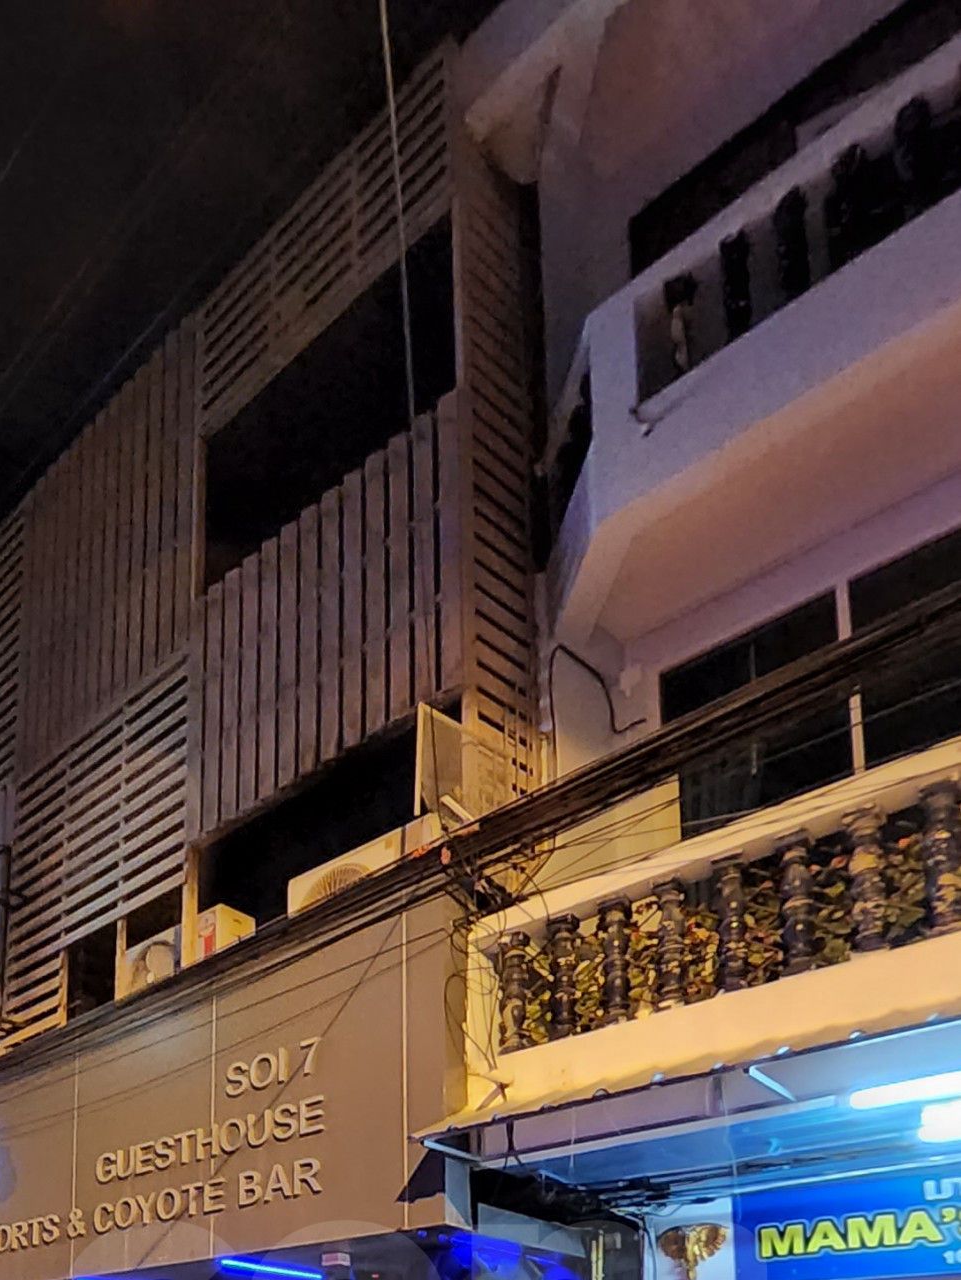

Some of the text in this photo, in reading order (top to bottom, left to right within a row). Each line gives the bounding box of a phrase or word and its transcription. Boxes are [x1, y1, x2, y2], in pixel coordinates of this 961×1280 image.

[225, 1036, 322, 1097] SOI 7
[95, 1094, 326, 1184] GUESTHOUSE
[66, 1206, 86, 1239] &
[93, 1176, 227, 1235] COYOTE
[238, 1157, 323, 1210] BAR
[760, 1207, 961, 1258] MAMA'
